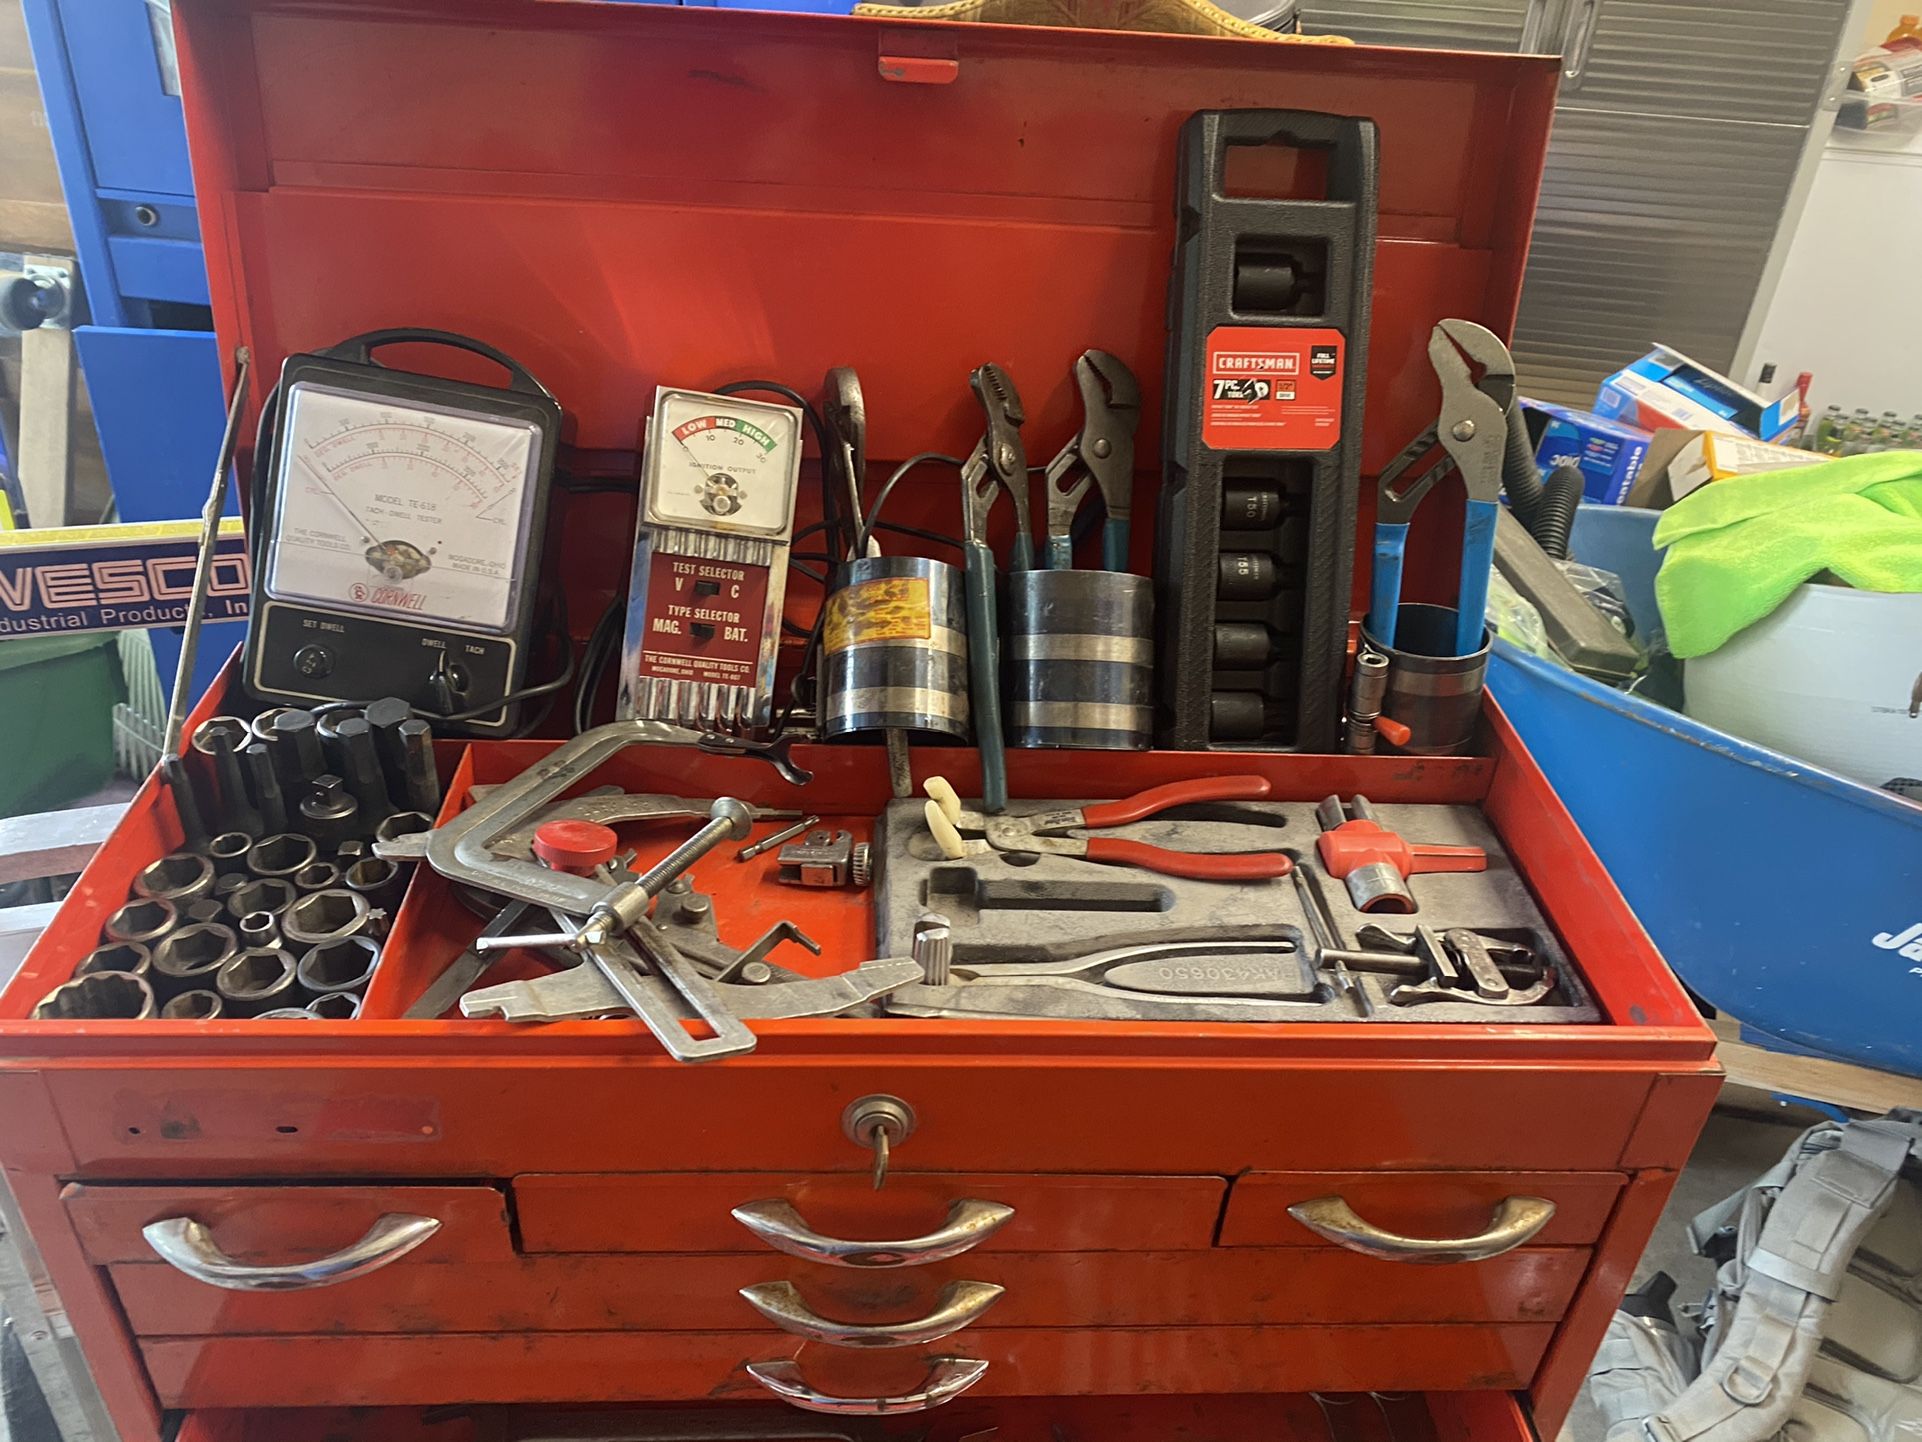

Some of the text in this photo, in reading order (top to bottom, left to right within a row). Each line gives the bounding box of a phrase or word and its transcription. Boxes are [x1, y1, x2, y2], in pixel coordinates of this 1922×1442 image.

[1218, 357, 1294, 370] CRAFTSMAN
[1213, 379, 1226, 400] 7
[681, 418, 771, 446] LOW MED HIGH
[733, 436, 745, 446] 20
[756, 452, 767, 464] 30
[689, 461, 757, 475] IGNITION OUTPUT
[374, 494, 404, 506] MODEL
[416, 513, 443, 525] TESTER
[294, 527, 308, 536] THE
[673, 562, 745, 581] TEST SELECTOR
[675, 577, 740, 599] V C
[370, 586, 428, 611] CORNWELL
[101, 605, 213, 624] Produc,
[668, 604, 741, 623] TYPE SELECTOR
[302, 619, 345, 633] SET DWELL
[652, 618, 749, 642] MAG. BAT.
[421, 638, 485, 655] DWELL TACH
[644, 654, 658, 663] THE
[658, 656, 692, 667] CORNWELL
[693, 660, 719, 670] QUALITY
[719, 663, 739, 672] TOOLS
